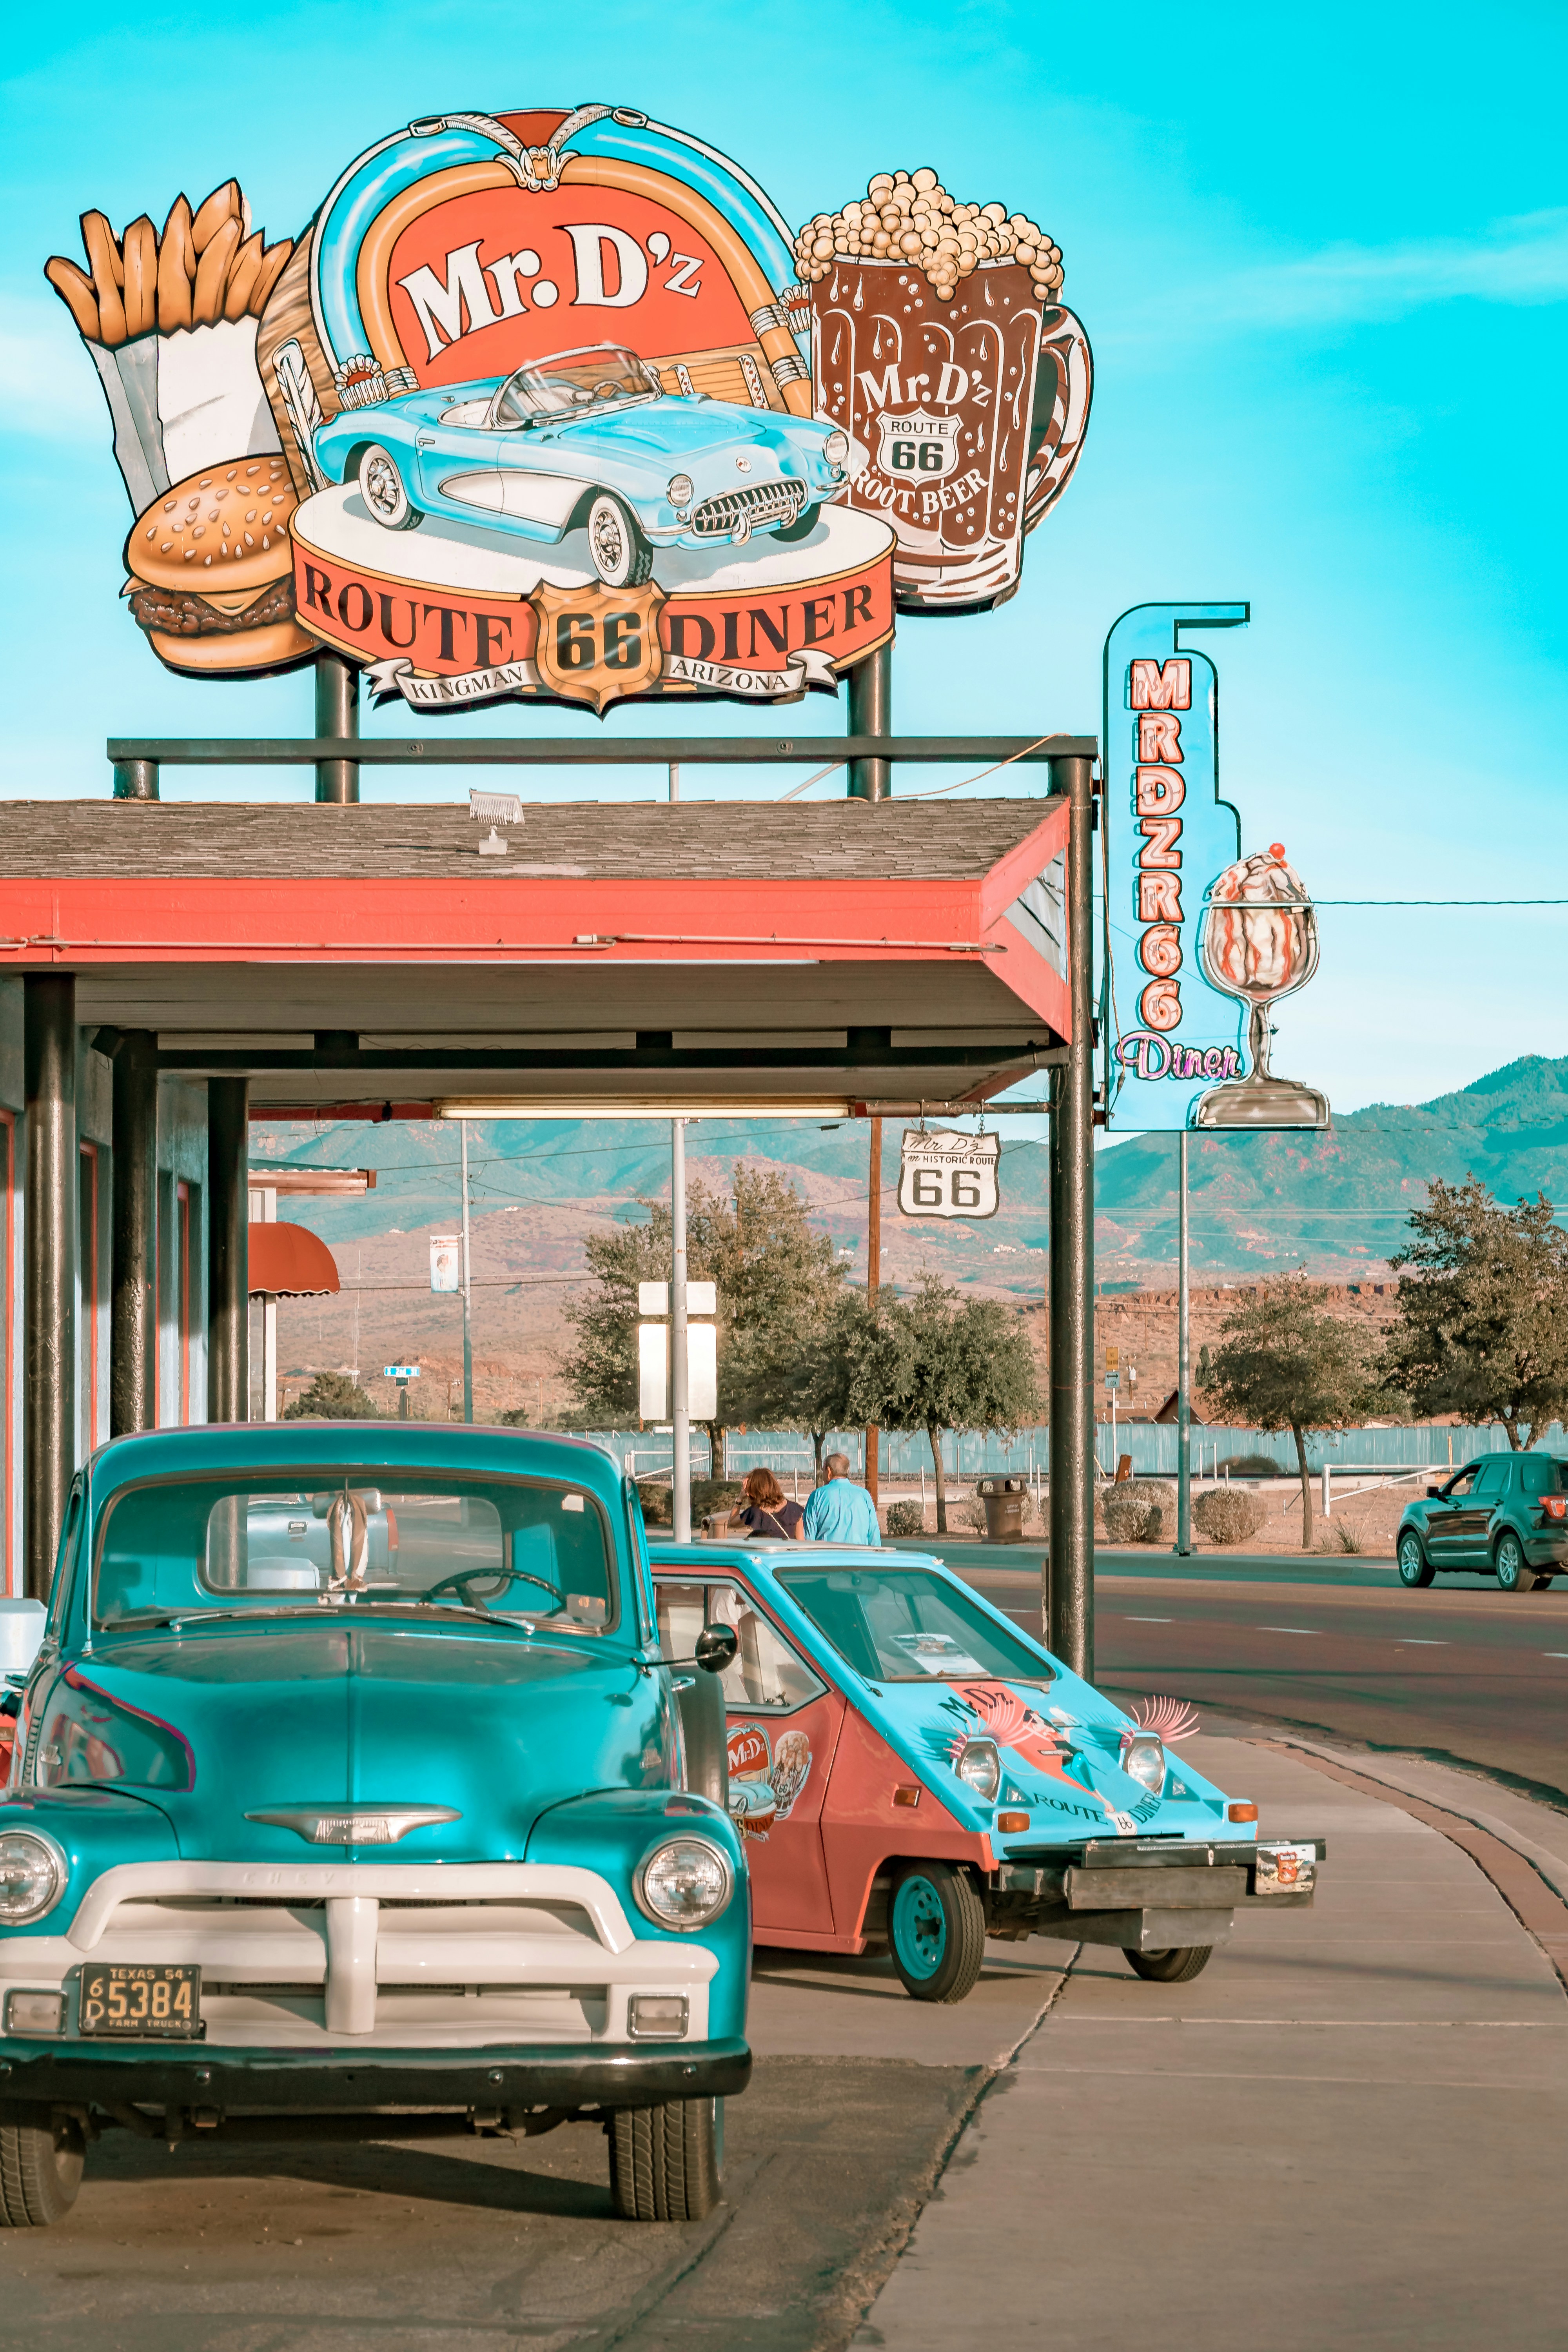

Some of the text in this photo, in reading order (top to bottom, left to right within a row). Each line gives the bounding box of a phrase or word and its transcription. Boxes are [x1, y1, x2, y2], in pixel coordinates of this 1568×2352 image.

[396, 223, 704, 364] Mr. D'z
[891, 421, 949, 435] ROUTE
[891, 441, 944, 470] 66
[850, 465, 989, 514] ROOT BEER
[303, 562, 875, 671] ROUTE 66 DINER
[410, 661, 789, 699] KINGMAN ARIZONA
[1114, 1031, 1241, 1081] Diner
[908, 1137, 943, 1151] Mr.
[923, 1156, 967, 1164] HISTORIC
[970, 1157, 996, 1165] ROUTE
[913, 1169, 981, 1207] 66
[1033, 1791, 1163, 1830] ROUTE 66 DINER
[89, 1976, 104, 1998] 6
[109, 1967, 156, 1980] TEXAS
[86, 1999, 105, 2020] D
[107, 1980, 192, 2019] 5384
[109, 2019, 181, 2029] FARM TRUCK
